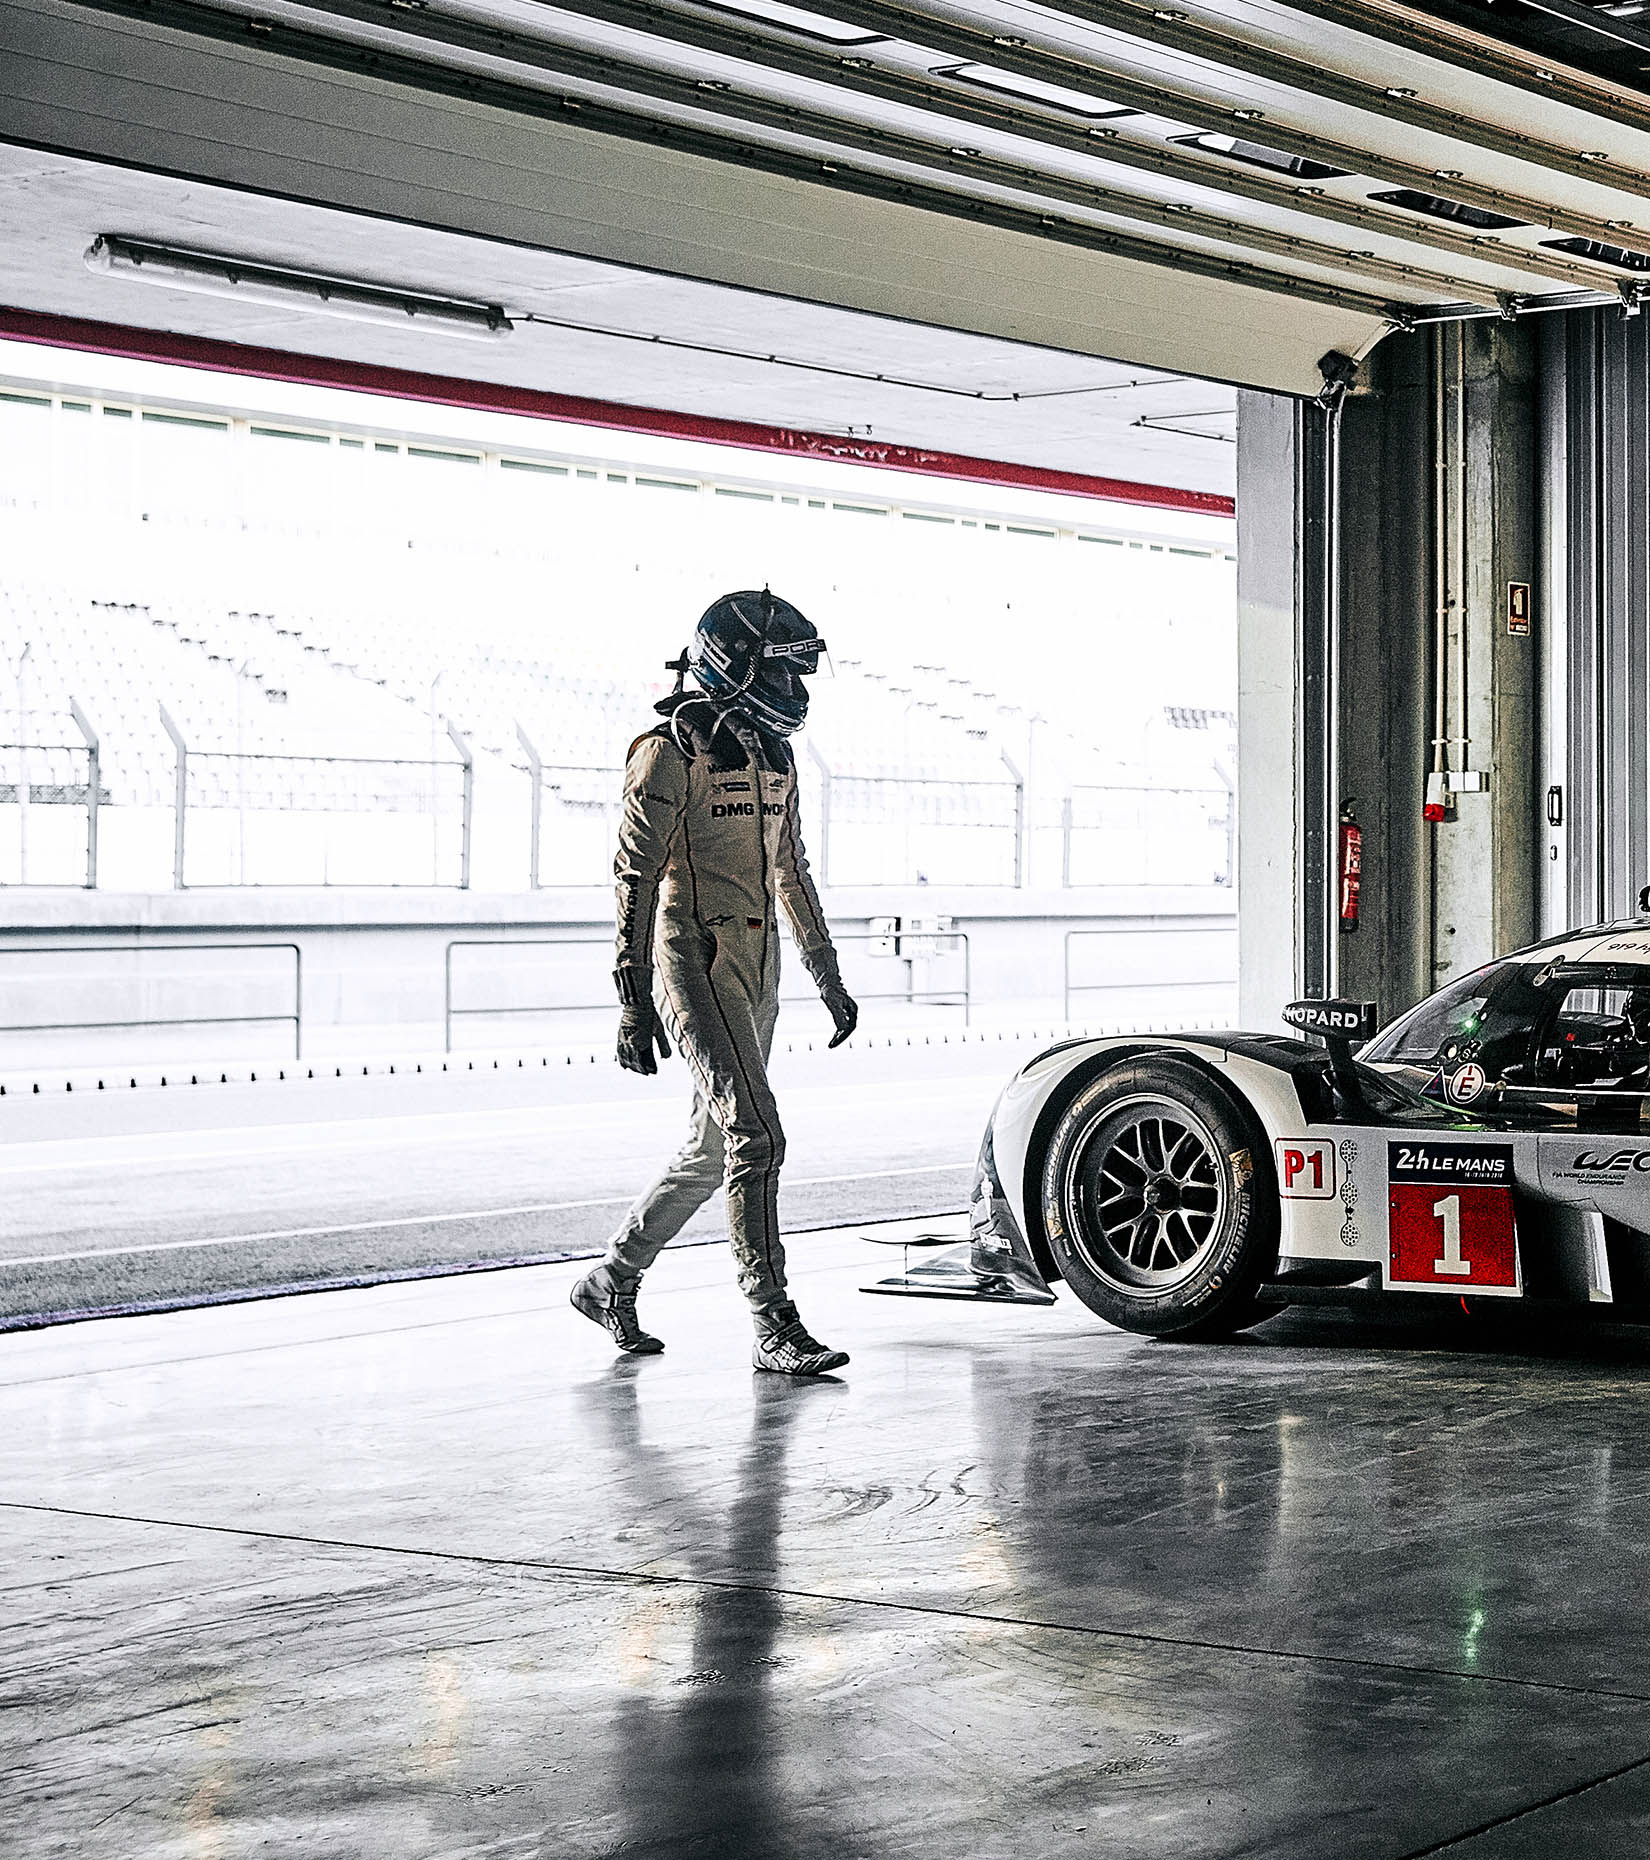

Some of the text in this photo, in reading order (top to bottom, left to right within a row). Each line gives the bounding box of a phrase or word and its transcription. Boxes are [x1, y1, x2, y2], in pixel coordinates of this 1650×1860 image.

[711, 802, 755, 818] DMG
[1607, 943, 1638, 951] 919
[1457, 1076, 1475, 1097] E
[1284, 1149, 1324, 1190] P1
[1432, 1157, 1455, 1170] LE
[1455, 1158, 1506, 1172] MANS
[1223, 1192, 1251, 1275] MICHELIN
[1434, 1195, 1471, 1275] 1
